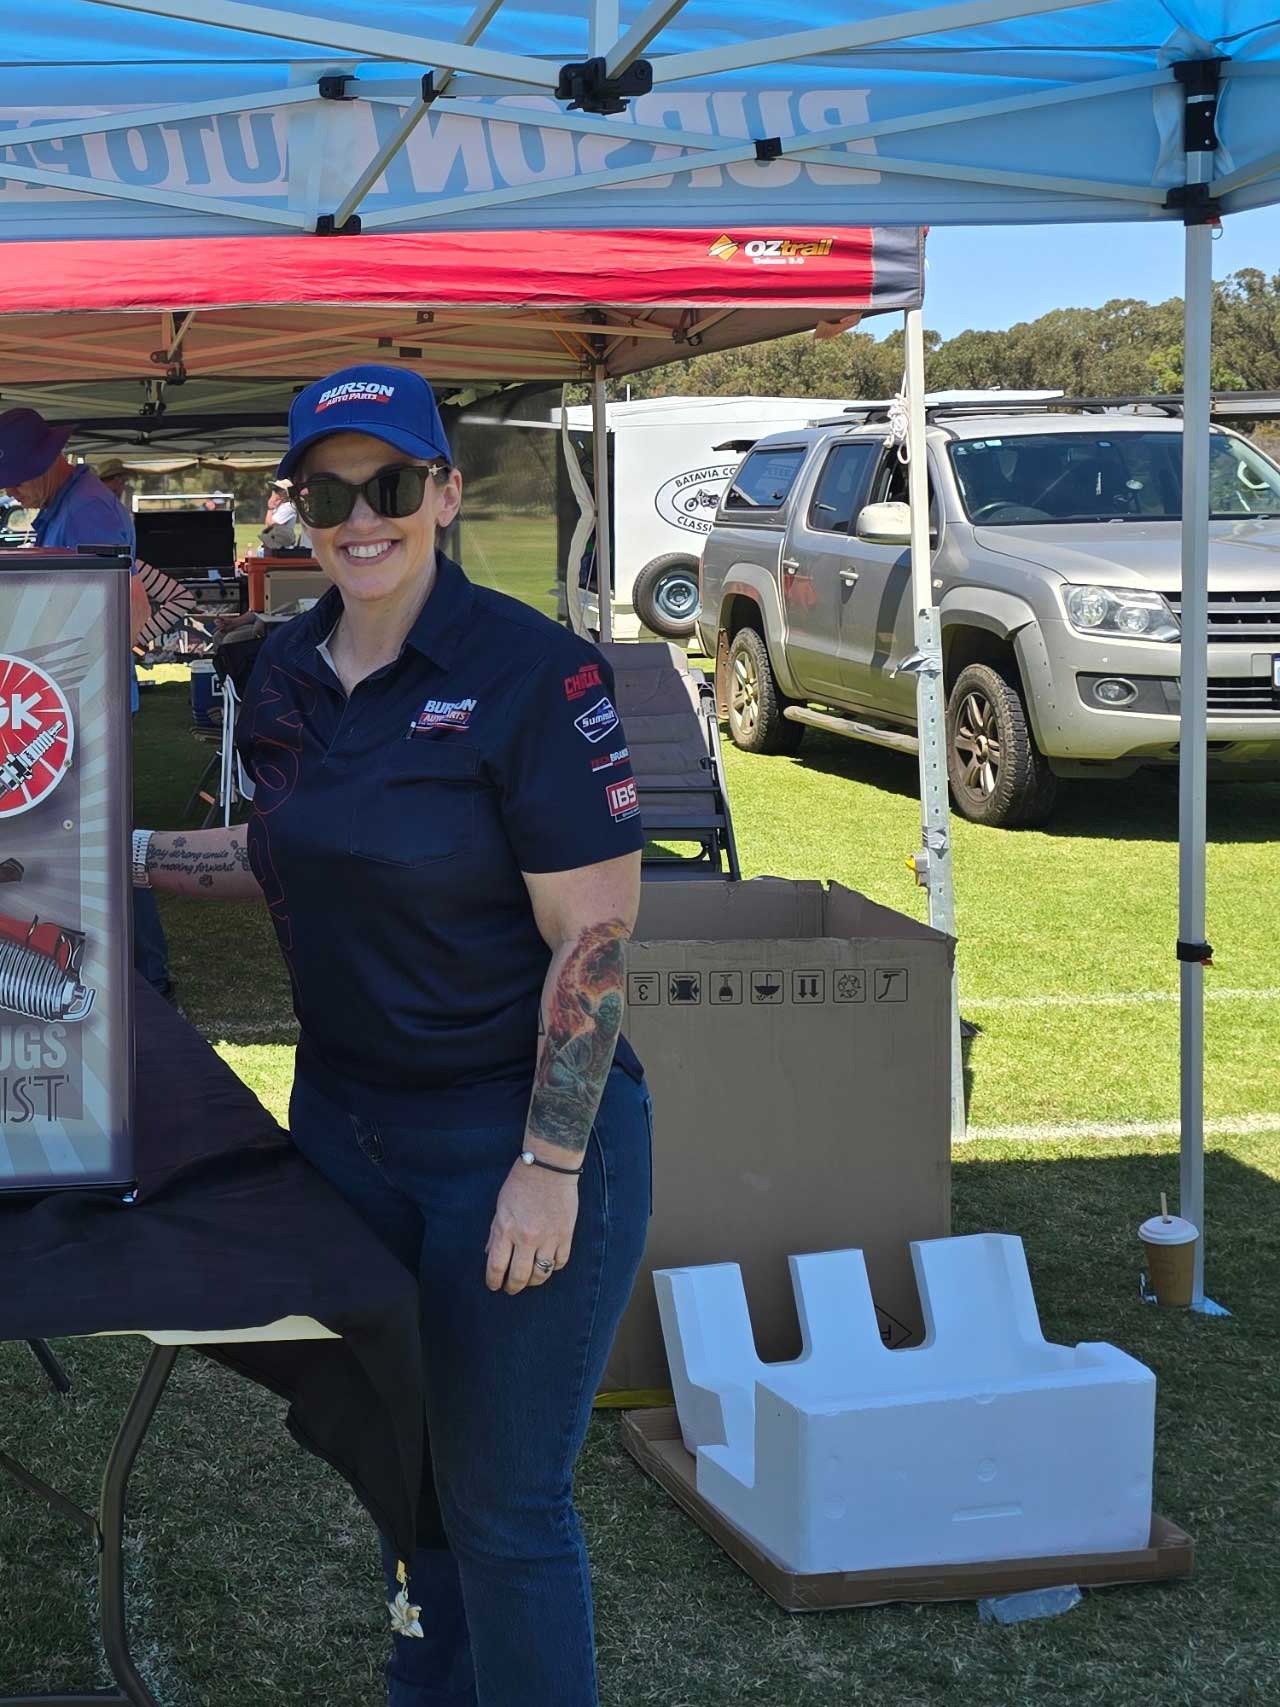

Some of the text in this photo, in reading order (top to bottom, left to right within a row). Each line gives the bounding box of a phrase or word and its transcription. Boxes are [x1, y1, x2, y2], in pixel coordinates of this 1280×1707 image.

[319, 382, 395, 404] BURSON
[675, 469, 719, 488] BATAVIA
[582, 709, 615, 728] Summit
[611, 783, 637, 810] IBS
